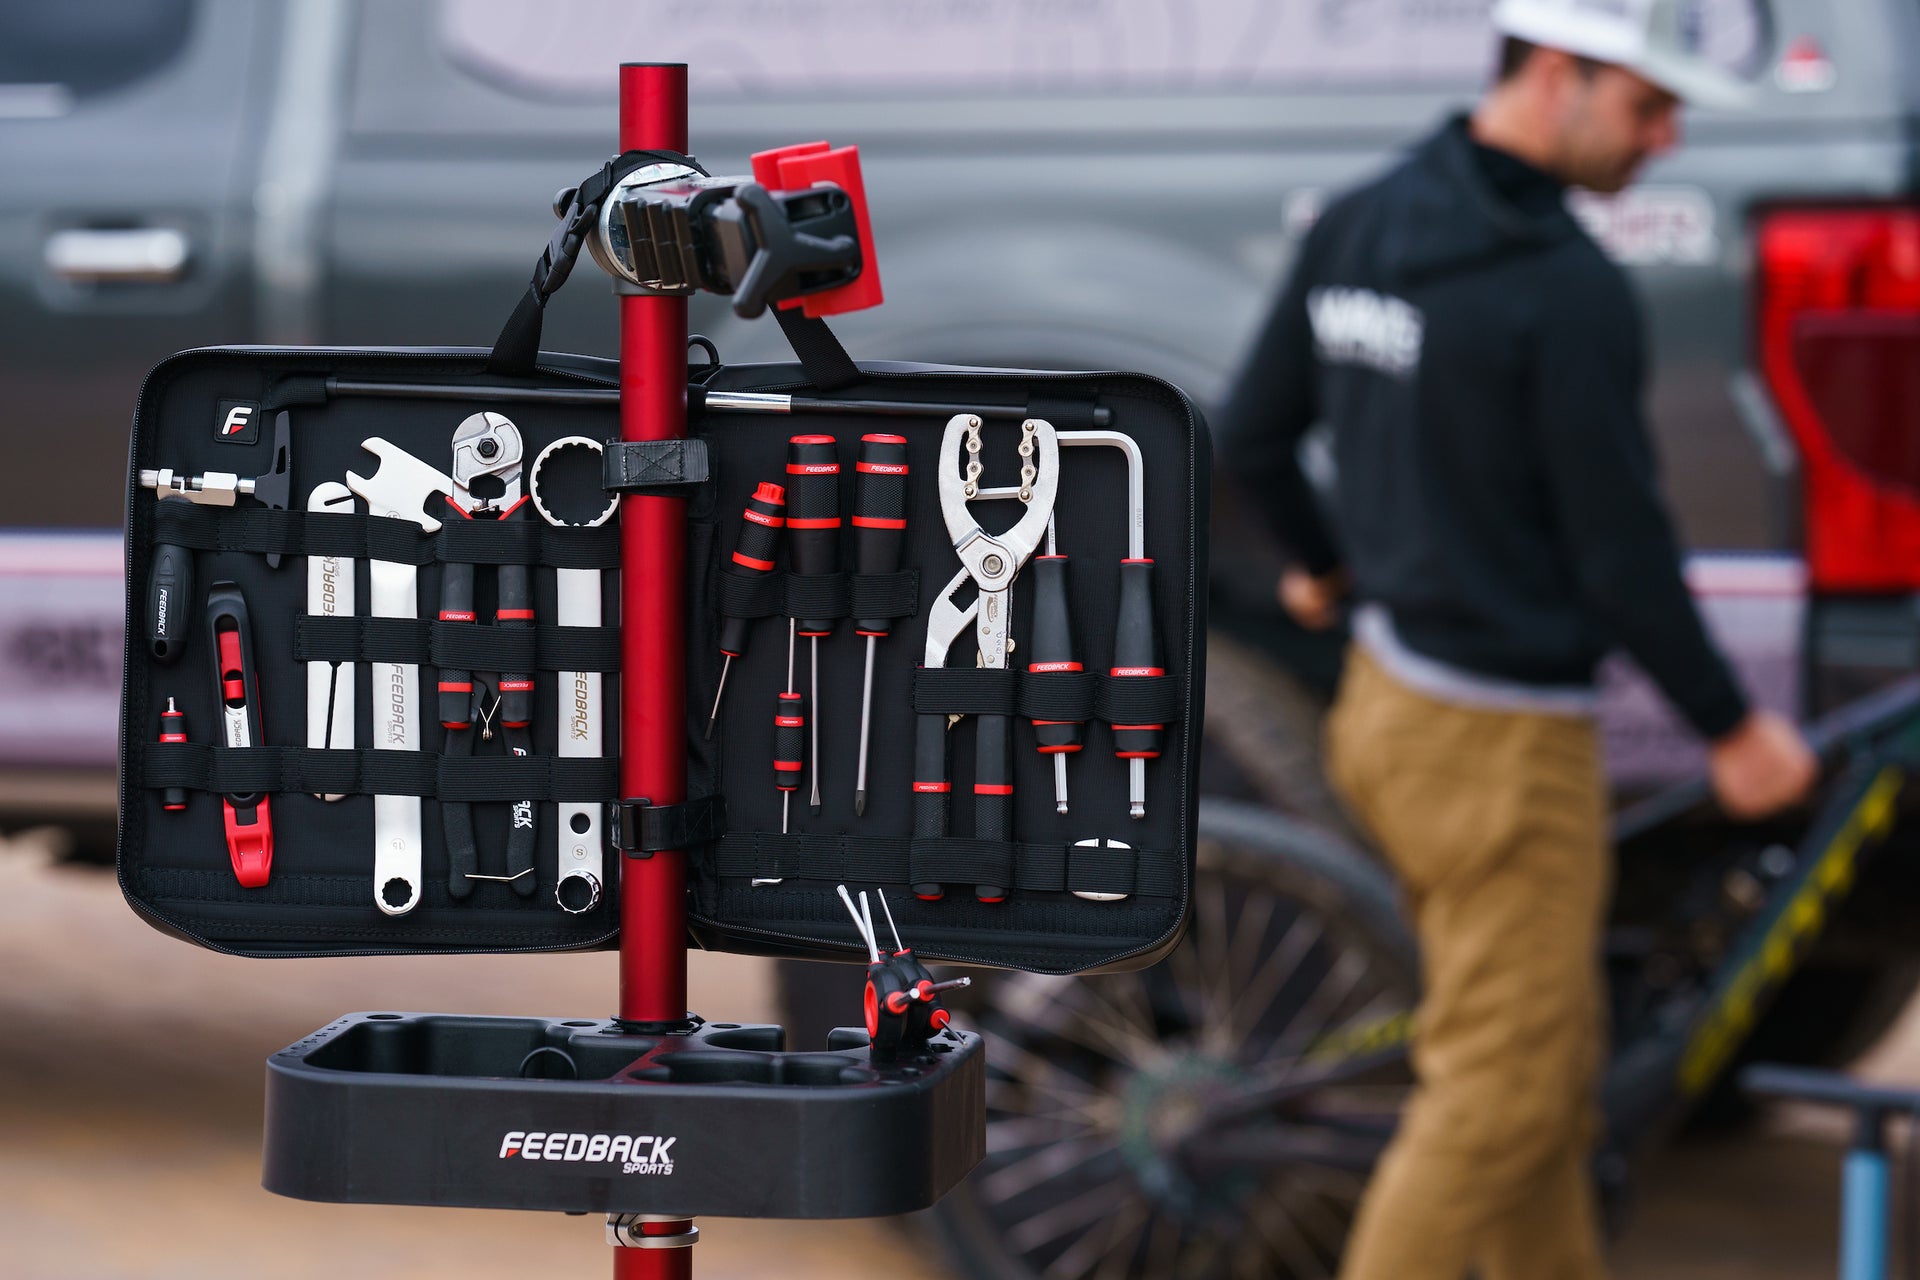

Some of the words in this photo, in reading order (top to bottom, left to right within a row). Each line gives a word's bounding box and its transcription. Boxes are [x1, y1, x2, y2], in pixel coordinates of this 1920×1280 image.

[805, 465, 837, 473] FEEDBACK
[871, 465, 904, 473] FEEDBACK
[158, 588, 168, 636] FEEDBACK
[1036, 663, 1069, 671] FEEDBACK
[391, 664, 405, 745] FEEDBACK
[575, 672, 588, 740] EEDBACK
[499, 1131, 677, 1164] FEEDBACK
[622, 1162, 674, 1176] SPORTS
